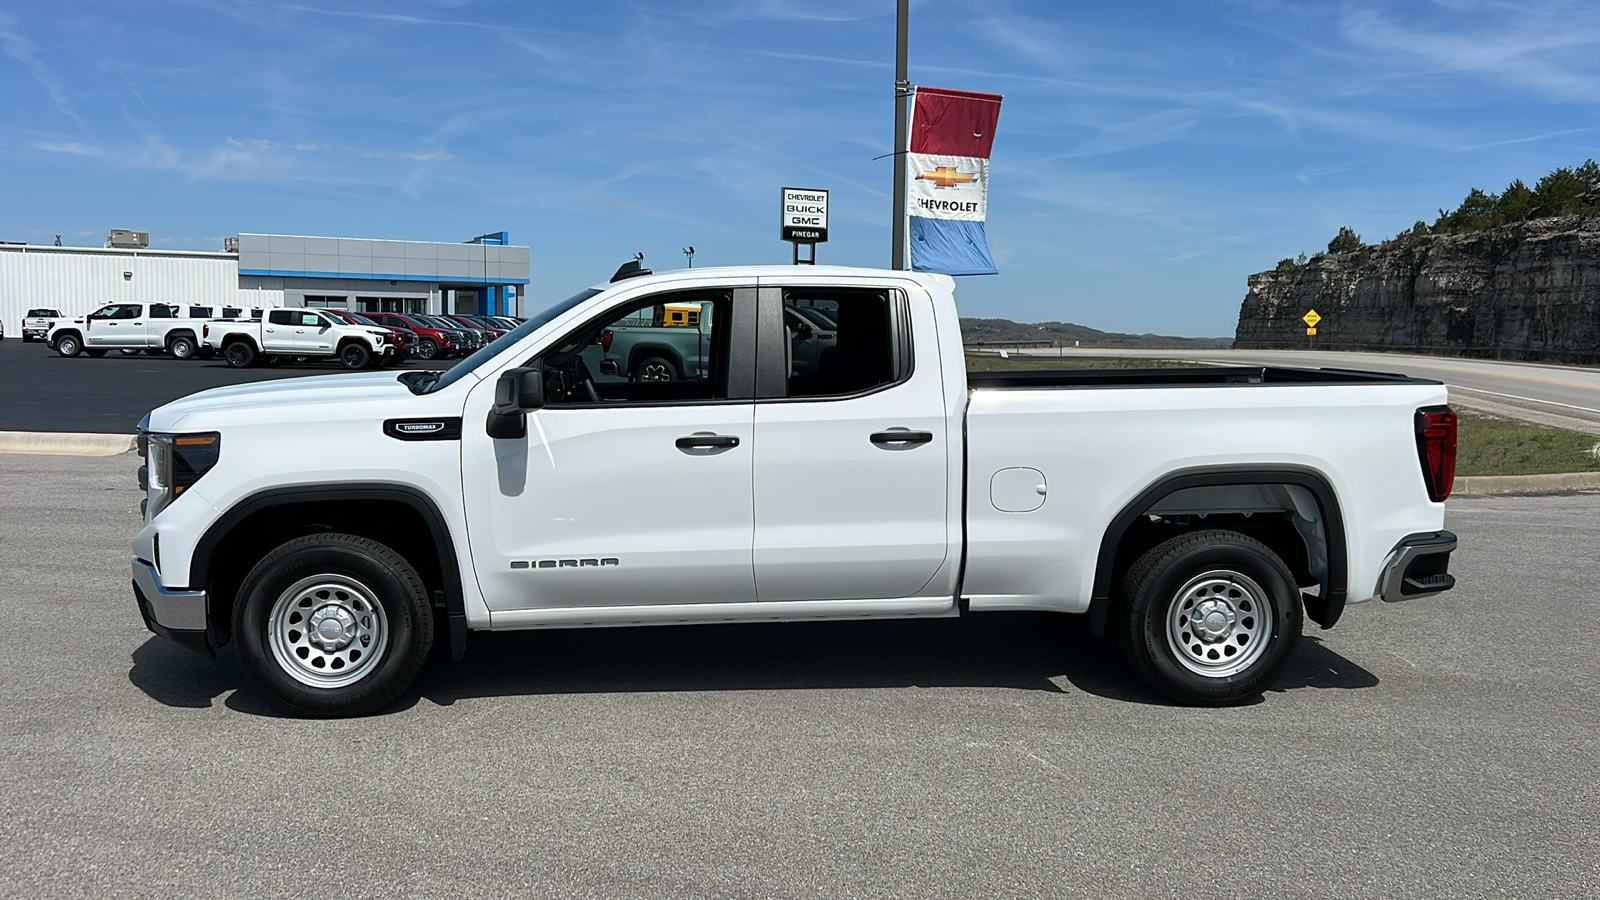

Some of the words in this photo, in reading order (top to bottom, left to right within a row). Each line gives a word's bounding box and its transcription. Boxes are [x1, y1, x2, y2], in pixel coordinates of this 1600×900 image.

[787, 193, 825, 202] CHEVROLET
[786, 204, 825, 214] BUICK
[791, 216, 820, 225] GMC
[791, 230, 820, 238] PINEGAR
[510, 557, 620, 569] SIERRA
